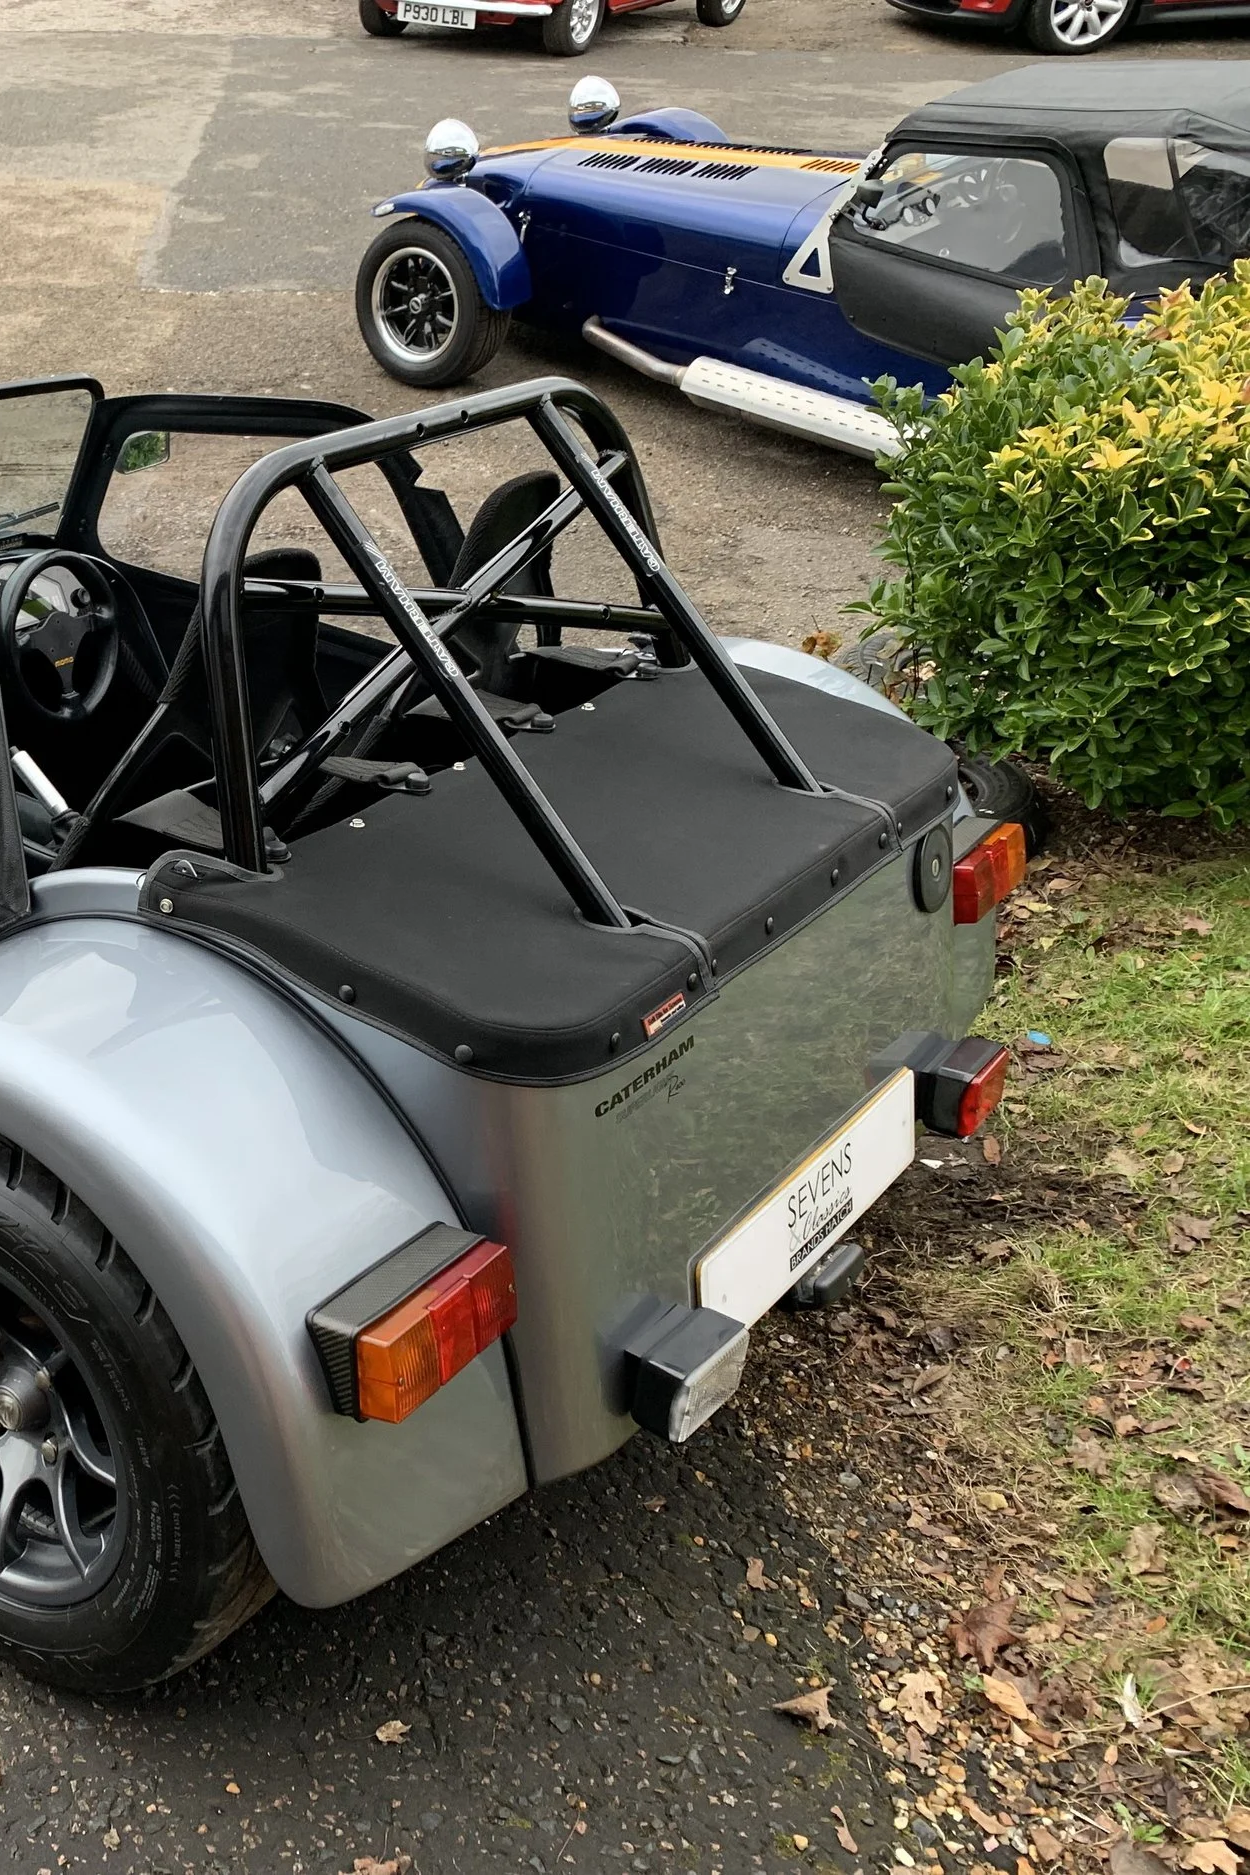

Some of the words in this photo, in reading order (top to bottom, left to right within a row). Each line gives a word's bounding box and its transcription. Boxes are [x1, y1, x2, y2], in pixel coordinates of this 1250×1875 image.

[403, 3, 439, 23] P930
[441, 8, 469, 27] LBL
[591, 468, 661, 572] CATERHAM
[375, 558, 459, 677] CATERHAM
[594, 1034, 695, 1118] CATERHAM
[787, 1142, 852, 1229] SEVENS
[802, 1185, 852, 1241] Classics
[791, 1231, 825, 1270] BRANDS
[825, 1201, 853, 1237] HATCH
